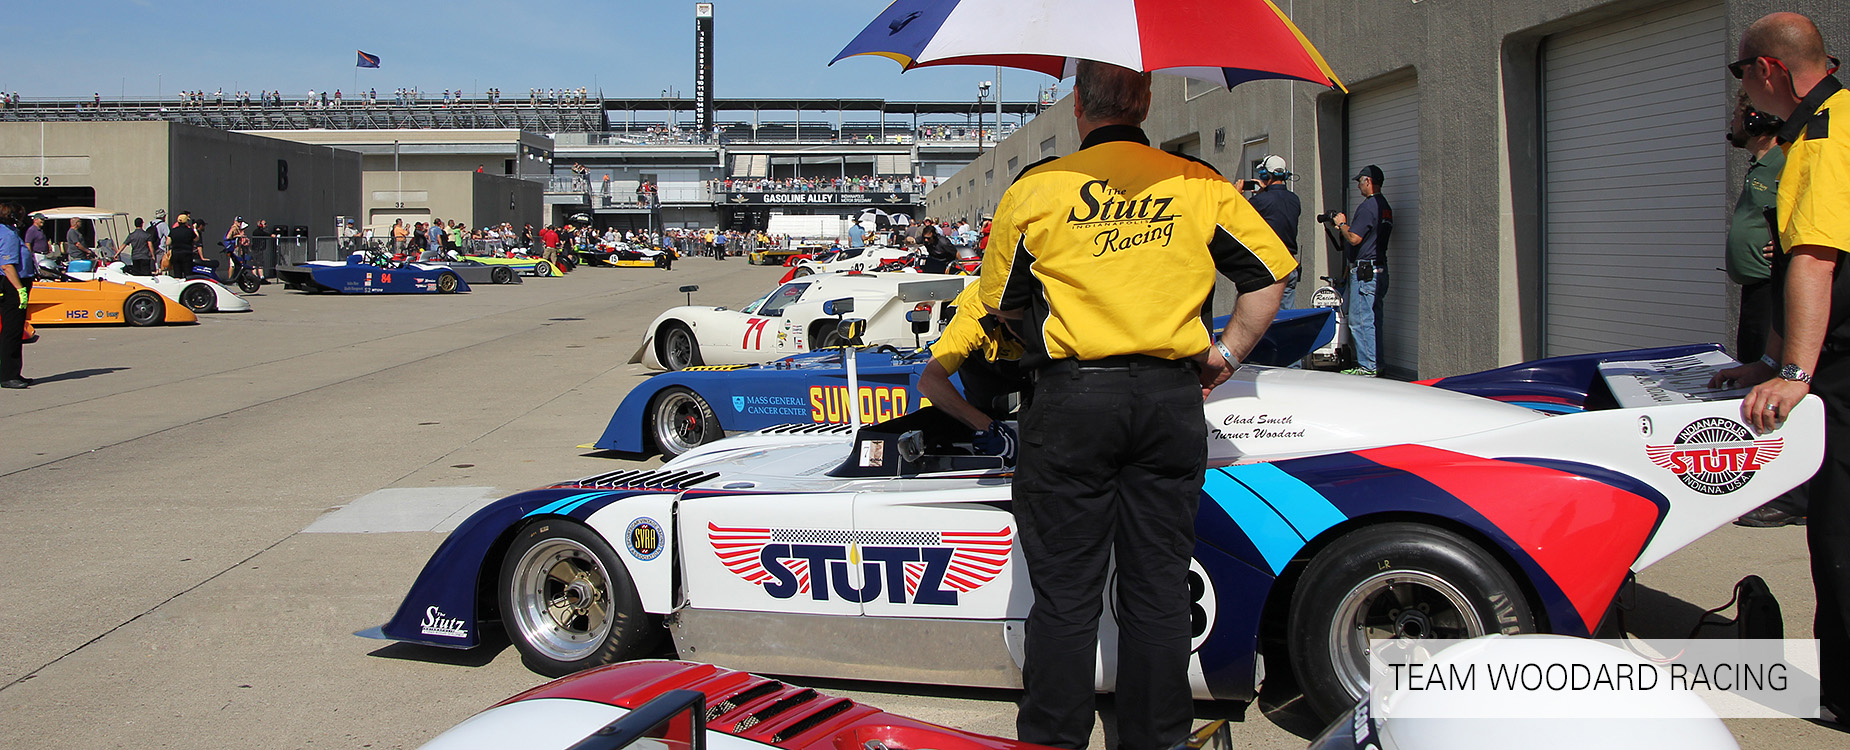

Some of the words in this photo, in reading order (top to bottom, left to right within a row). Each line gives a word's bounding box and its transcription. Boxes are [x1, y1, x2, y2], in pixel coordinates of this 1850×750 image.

[33, 176, 50, 186] 32
[278, 159, 288, 192] B
[763, 194, 806, 203] GASOLINE
[807, 194, 833, 203] ALLEY
[1066, 179, 1175, 224] Stutz
[1072, 220, 1150, 230] INDIANAPOLIS
[1093, 222, 1174, 258] Racing
[610, 255, 618, 263] 15
[381, 273, 392, 284] 84
[66, 310, 88, 318] HS2
[742, 318, 770, 350] 71
[747, 396, 768, 404] MASS
[769, 396, 806, 406] GENERAL
[809, 385, 908, 424] SUNOCO
[748, 406, 778, 414] CANCER
[779, 407, 807, 416] CENTER
[1223, 414, 1255, 426] Chad
[1256, 414, 1293, 424] Smith
[1211, 428, 1250, 440] Turner
[1252, 428, 1306, 438] Woodard
[1680, 419, 1746, 440] INDIANAPOLIS
[863, 446, 870, 458] 7
[1670, 446, 1762, 474] STUTZ
[1726, 474, 1752, 492] U.S.A.
[634, 528, 656, 550] SVRA
[1377, 560, 1391, 570] LR
[761, 543, 959, 606] STUTZ
[420, 605, 465, 632] Stutz
